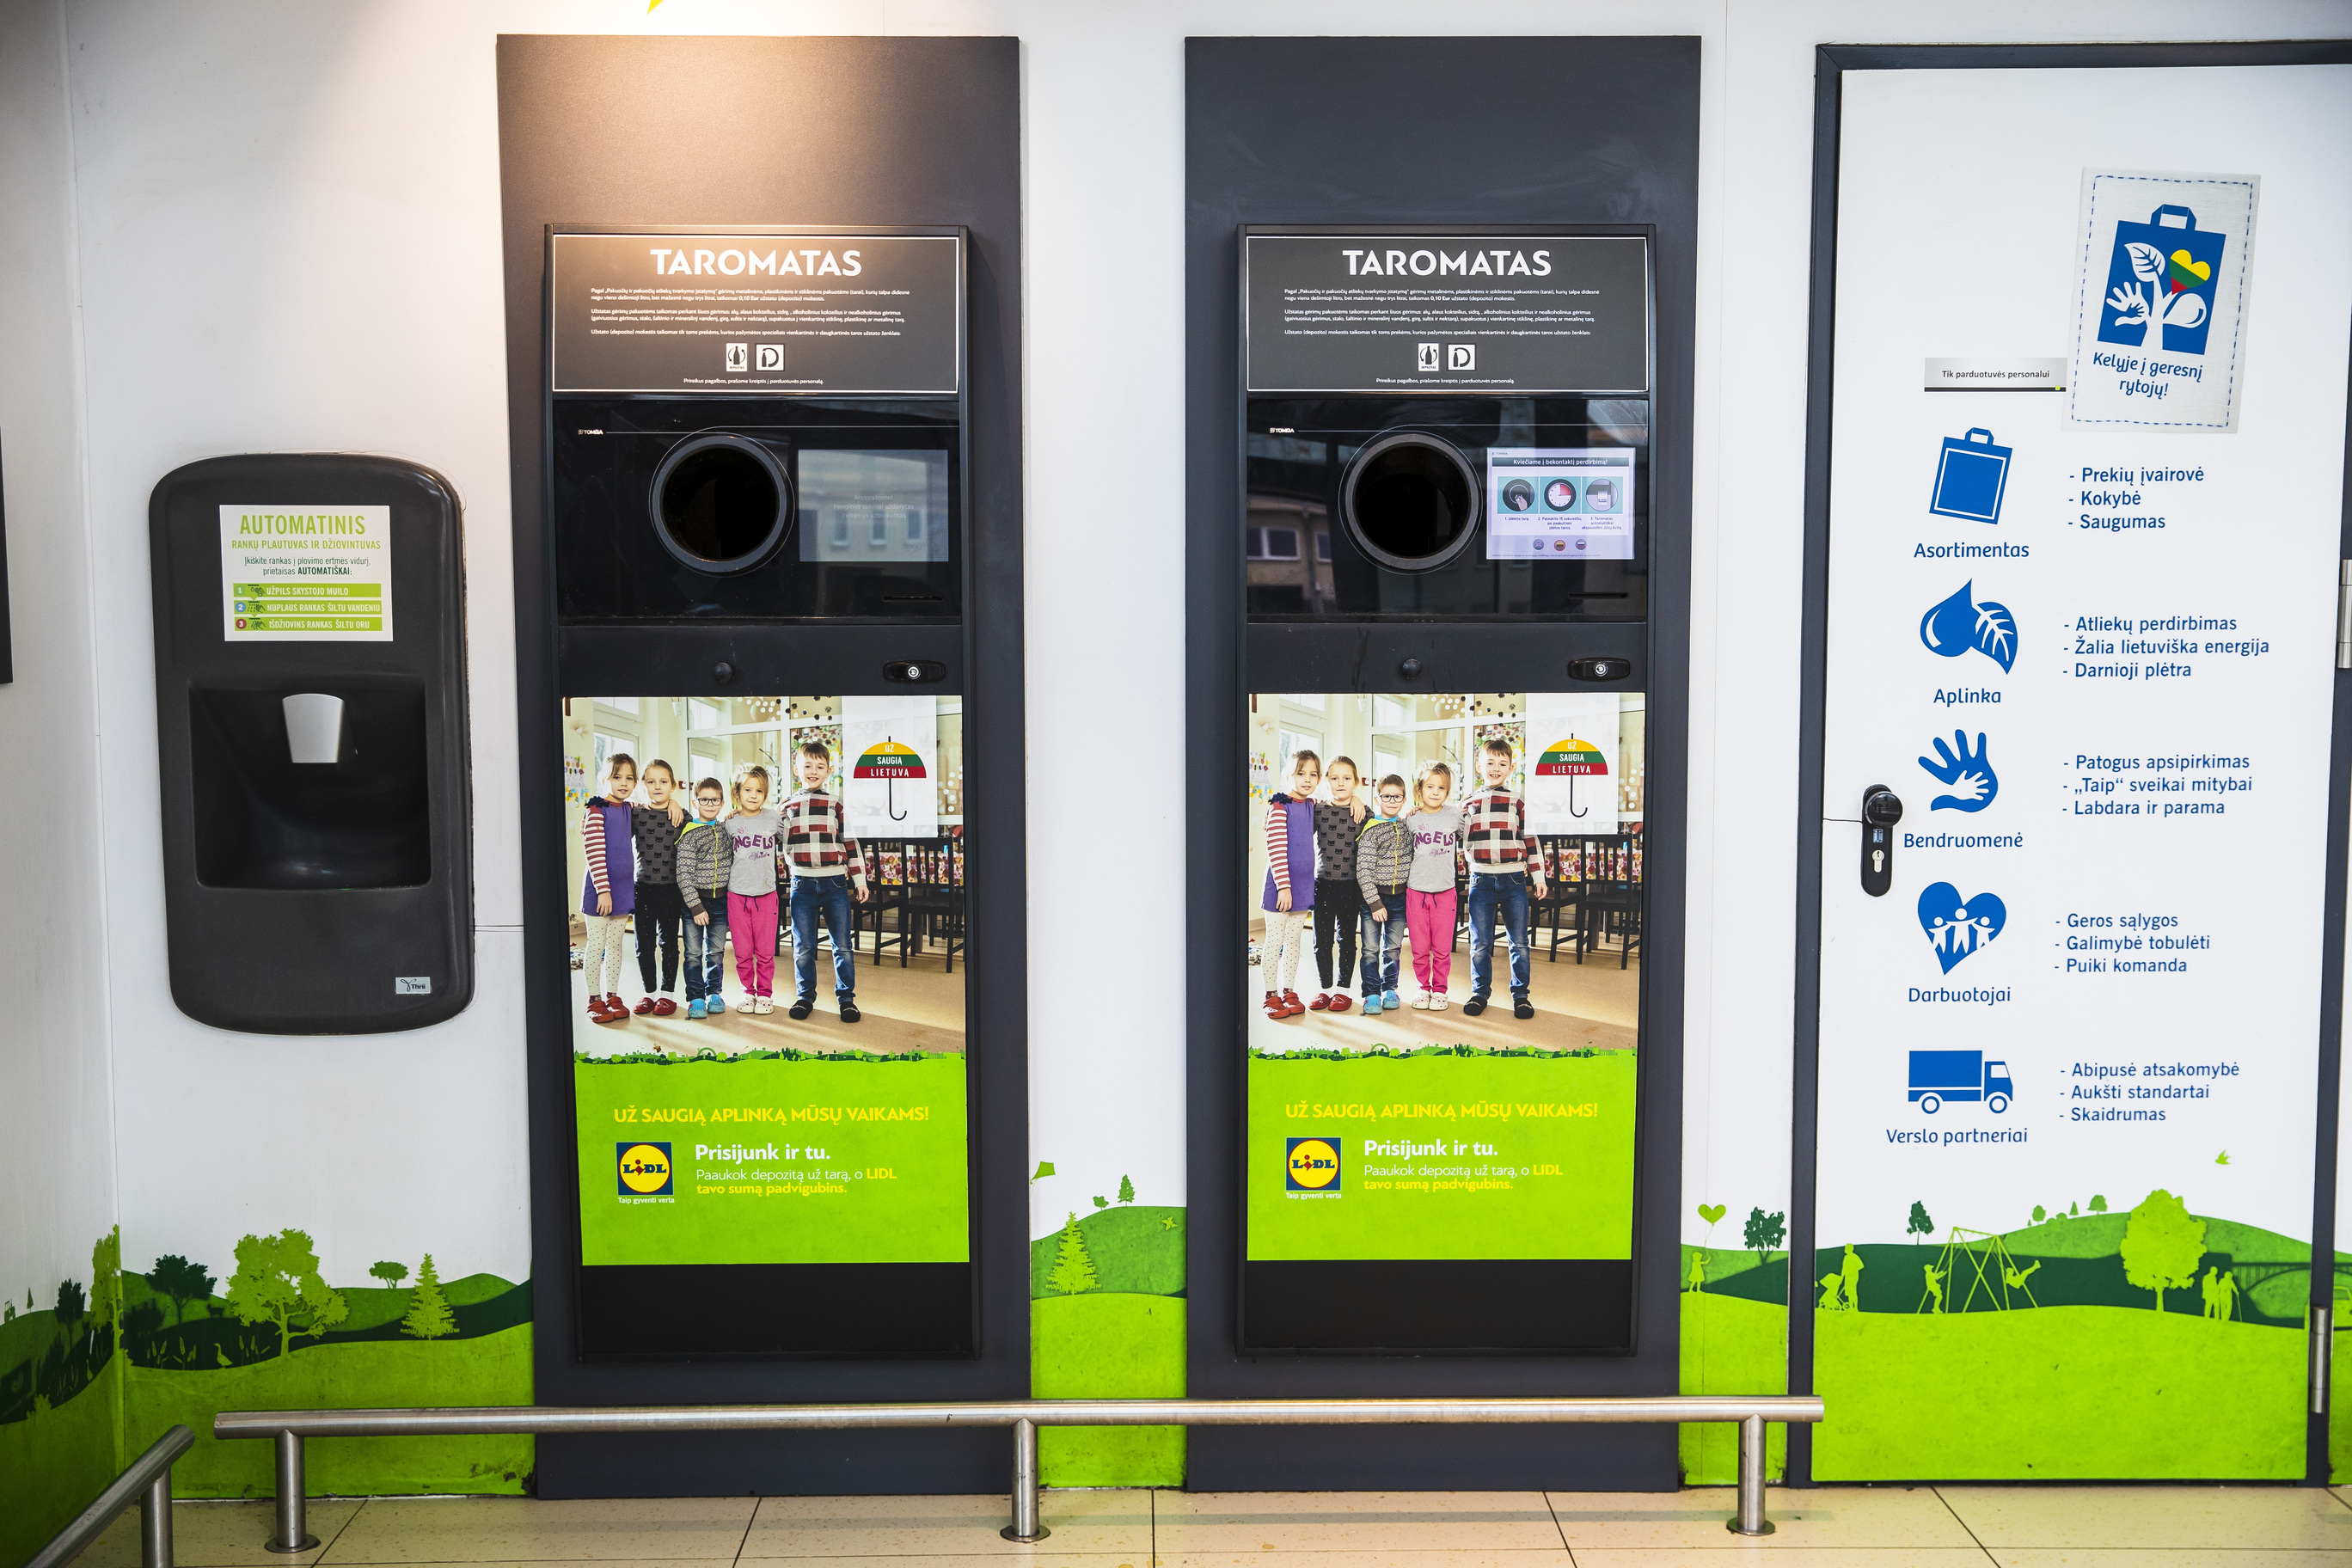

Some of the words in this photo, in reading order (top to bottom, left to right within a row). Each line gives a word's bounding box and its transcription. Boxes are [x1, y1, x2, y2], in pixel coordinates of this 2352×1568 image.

[650, 249, 862, 277] TAROMATAS
[1342, 250, 1552, 276] TAROMATAS
[1942, 370, 1954, 378] Tik
[1956, 370, 2006, 381] parduotuvės
[2008, 370, 2049, 381] personalui
[2092, 352, 2139, 374] Kelyje
[2141, 358, 2147, 376] į
[2150, 360, 2203, 383] geresnį
[2119, 378, 2168, 399] rytojų!
[2081, 467, 2135, 486] Prekių
[2141, 467, 2204, 485] įvairovė
[2080, 491, 2141, 509] Kokybė
[240, 515, 365, 535] AUTOMATINIS
[2079, 514, 2165, 532] Saugumas
[232, 541, 258, 551] RANKŲ
[262, 541, 308, 549] PLAUTUVAS
[322, 538, 381, 549] DŽIOVINTUVAS
[1914, 542, 2030, 558] Asortimentas
[244, 556, 267, 565] Įkiškite
[293, 557, 296, 566] į
[298, 557, 323, 566] plovimo
[350, 557, 371, 567] vidurį,
[263, 567, 296, 576] prietaisas
[298, 565, 352, 575] AUTOMATIŠKAI:
[267, 586, 291, 595] UŽPILS
[328, 603, 346, 611] ŠILTU
[269, 619, 304, 628] IŠDŽIOVINS
[336, 619, 353, 628] ŠILTU
[2075, 616, 2133, 634] Atliekų
[2140, 616, 2237, 634] perdirbimas
[2075, 636, 2115, 655] Žalia
[2122, 638, 2198, 654] lietuviška
[2204, 640, 2269, 657] energija
[2075, 663, 2139, 680] Darnioji
[2145, 663, 2191, 680] plėtra
[1933, 689, 2001, 707] Aplinka
[885, 744, 894, 752] UŽ
[1568, 741, 1576, 750] UŽ
[877, 756, 903, 766] SAUGIĄ
[1559, 753, 1584, 763] SAUGIĄ
[2076, 755, 2141, 772] Patogus
[2147, 754, 2251, 771] apsipirkimas
[2129, 778, 2185, 793] sveikai
[2191, 778, 2252, 794] mitybai
[2074, 800, 2141, 816] Labdara
[2147, 801, 2158, 815] ir
[2164, 802, 2225, 818] parama
[1904, 832, 2023, 849] Bendruomenė
[2067, 914, 2114, 929] Geros
[2120, 914, 2178, 931] sąlygos
[2067, 935, 2143, 952] Galimybė
[2149, 935, 2210, 952] tobulėti
[2067, 959, 2106, 973] Puiki
[2113, 958, 2188, 974] komanda
[1908, 988, 2011, 1006] Darbuotojai
[2072, 1063, 2136, 1080] Abipusė
[2143, 1063, 2239, 1080] atsakomybė
[2071, 1084, 2121, 1100] Aukšti
[2128, 1084, 2209, 1099] standartai
[615, 1105, 639, 1123] UŽ
[642, 1108, 706, 1126] SAUGIĄ
[710, 1108, 787, 1126] APLINKĄ
[791, 1105, 841, 1124] MŪSŲ
[846, 1107, 928, 1122] VAIKAMS!
[1286, 1100, 1308, 1118] UŽ
[1313, 1104, 1375, 1122] SAUGIĄ
[1381, 1104, 1456, 1122] APLINKĄ
[1461, 1101, 1511, 1122] MŪSŲ
[1516, 1104, 1598, 1118] VAIKAMS!
[2071, 1107, 2166, 1122] Skaidrumas
[1887, 1129, 1939, 1144] Verslo
[1944, 1128, 2028, 1147] partneriai
[695, 1143, 779, 1164] Prisijunk
[786, 1143, 799, 1160] ir
[805, 1146, 830, 1160] tu.
[1364, 1139, 1448, 1161] Prisijunk
[1454, 1139, 1467, 1155] ir
[1473, 1142, 1498, 1155] tu.
[696, 1168, 747, 1180] Paaukok
[751, 1168, 803, 1183] depozitą
[807, 1168, 821, 1180] už
[825, 1171, 851, 1182] tarą,
[867, 1168, 897, 1179] LIDL
[1364, 1164, 1414, 1176] Paaukok
[1418, 1164, 1470, 1179] depozitą
[1474, 1164, 1488, 1176] už
[1491, 1167, 1517, 1179] tarą,
[1533, 1164, 1563, 1175] LIDL
[696, 1185, 725, 1194] tavo
[729, 1185, 763, 1197] sumą
[766, 1183, 847, 1196] padvigubins.
[1364, 1180, 1392, 1190] tavo
[1395, 1181, 1430, 1192] sumą
[1432, 1179, 1513, 1191] padvigubins.
[634, 1197, 656, 1205] gyventi
[1301, 1191, 1323, 1200] gyventi
